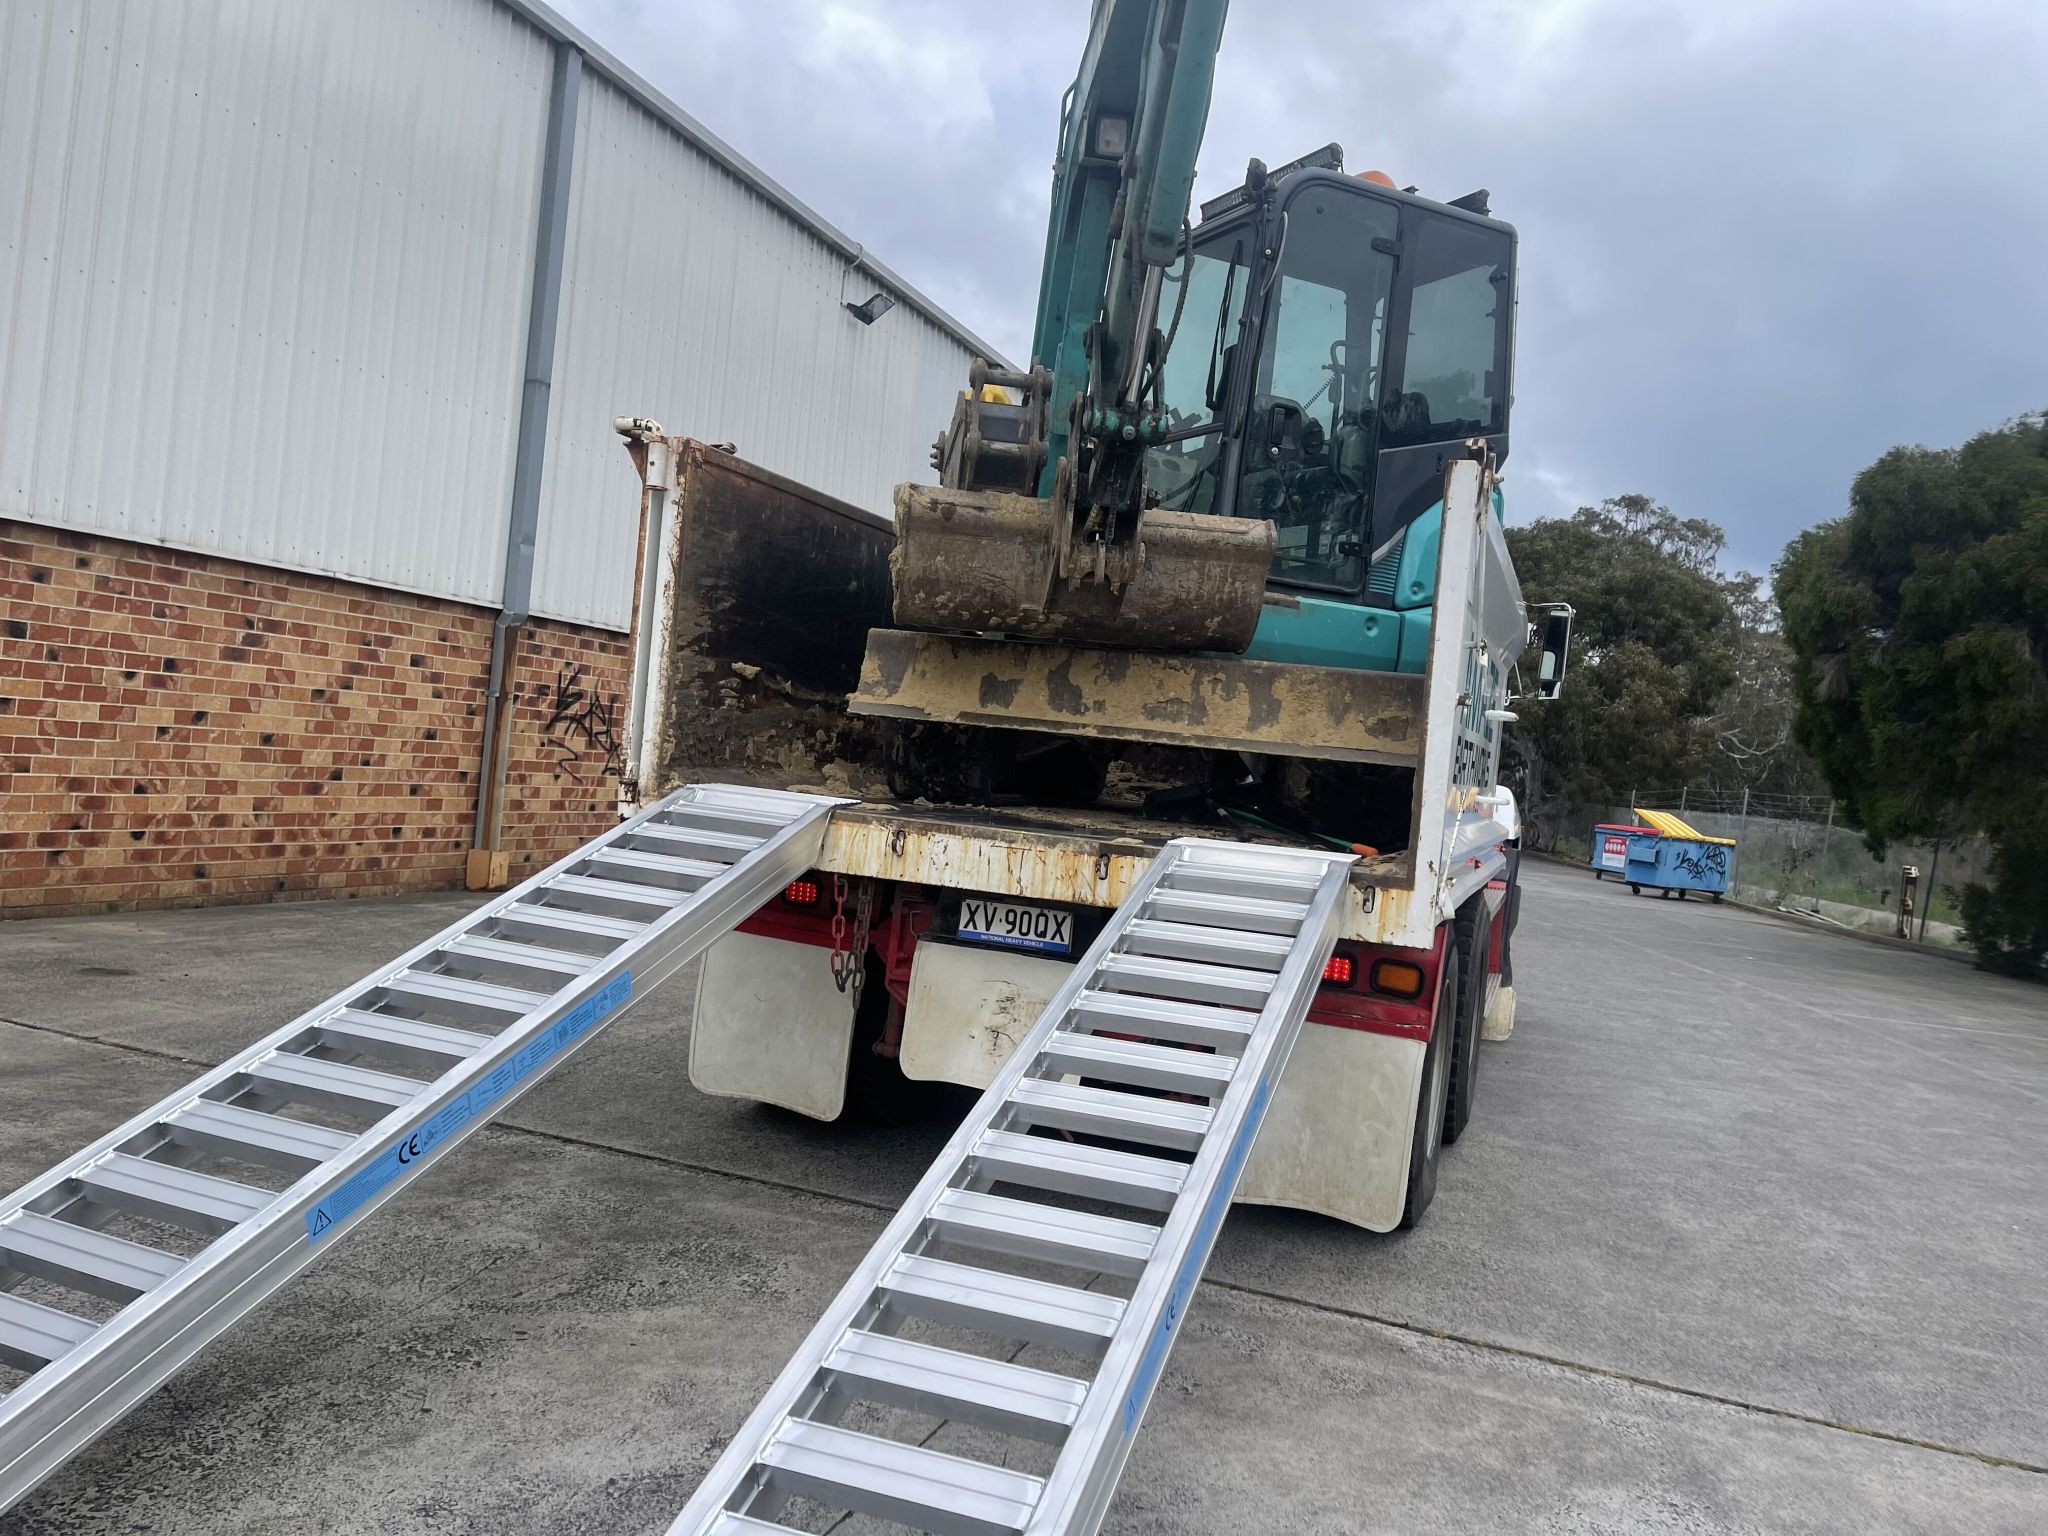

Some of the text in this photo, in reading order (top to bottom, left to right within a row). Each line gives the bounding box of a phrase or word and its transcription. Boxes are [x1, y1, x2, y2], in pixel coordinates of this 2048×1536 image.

[980, 933, 1005, 942] NATIONAL
[1023, 940, 1044, 948] VEHICLE
[399, 1133, 421, 1165] CE
